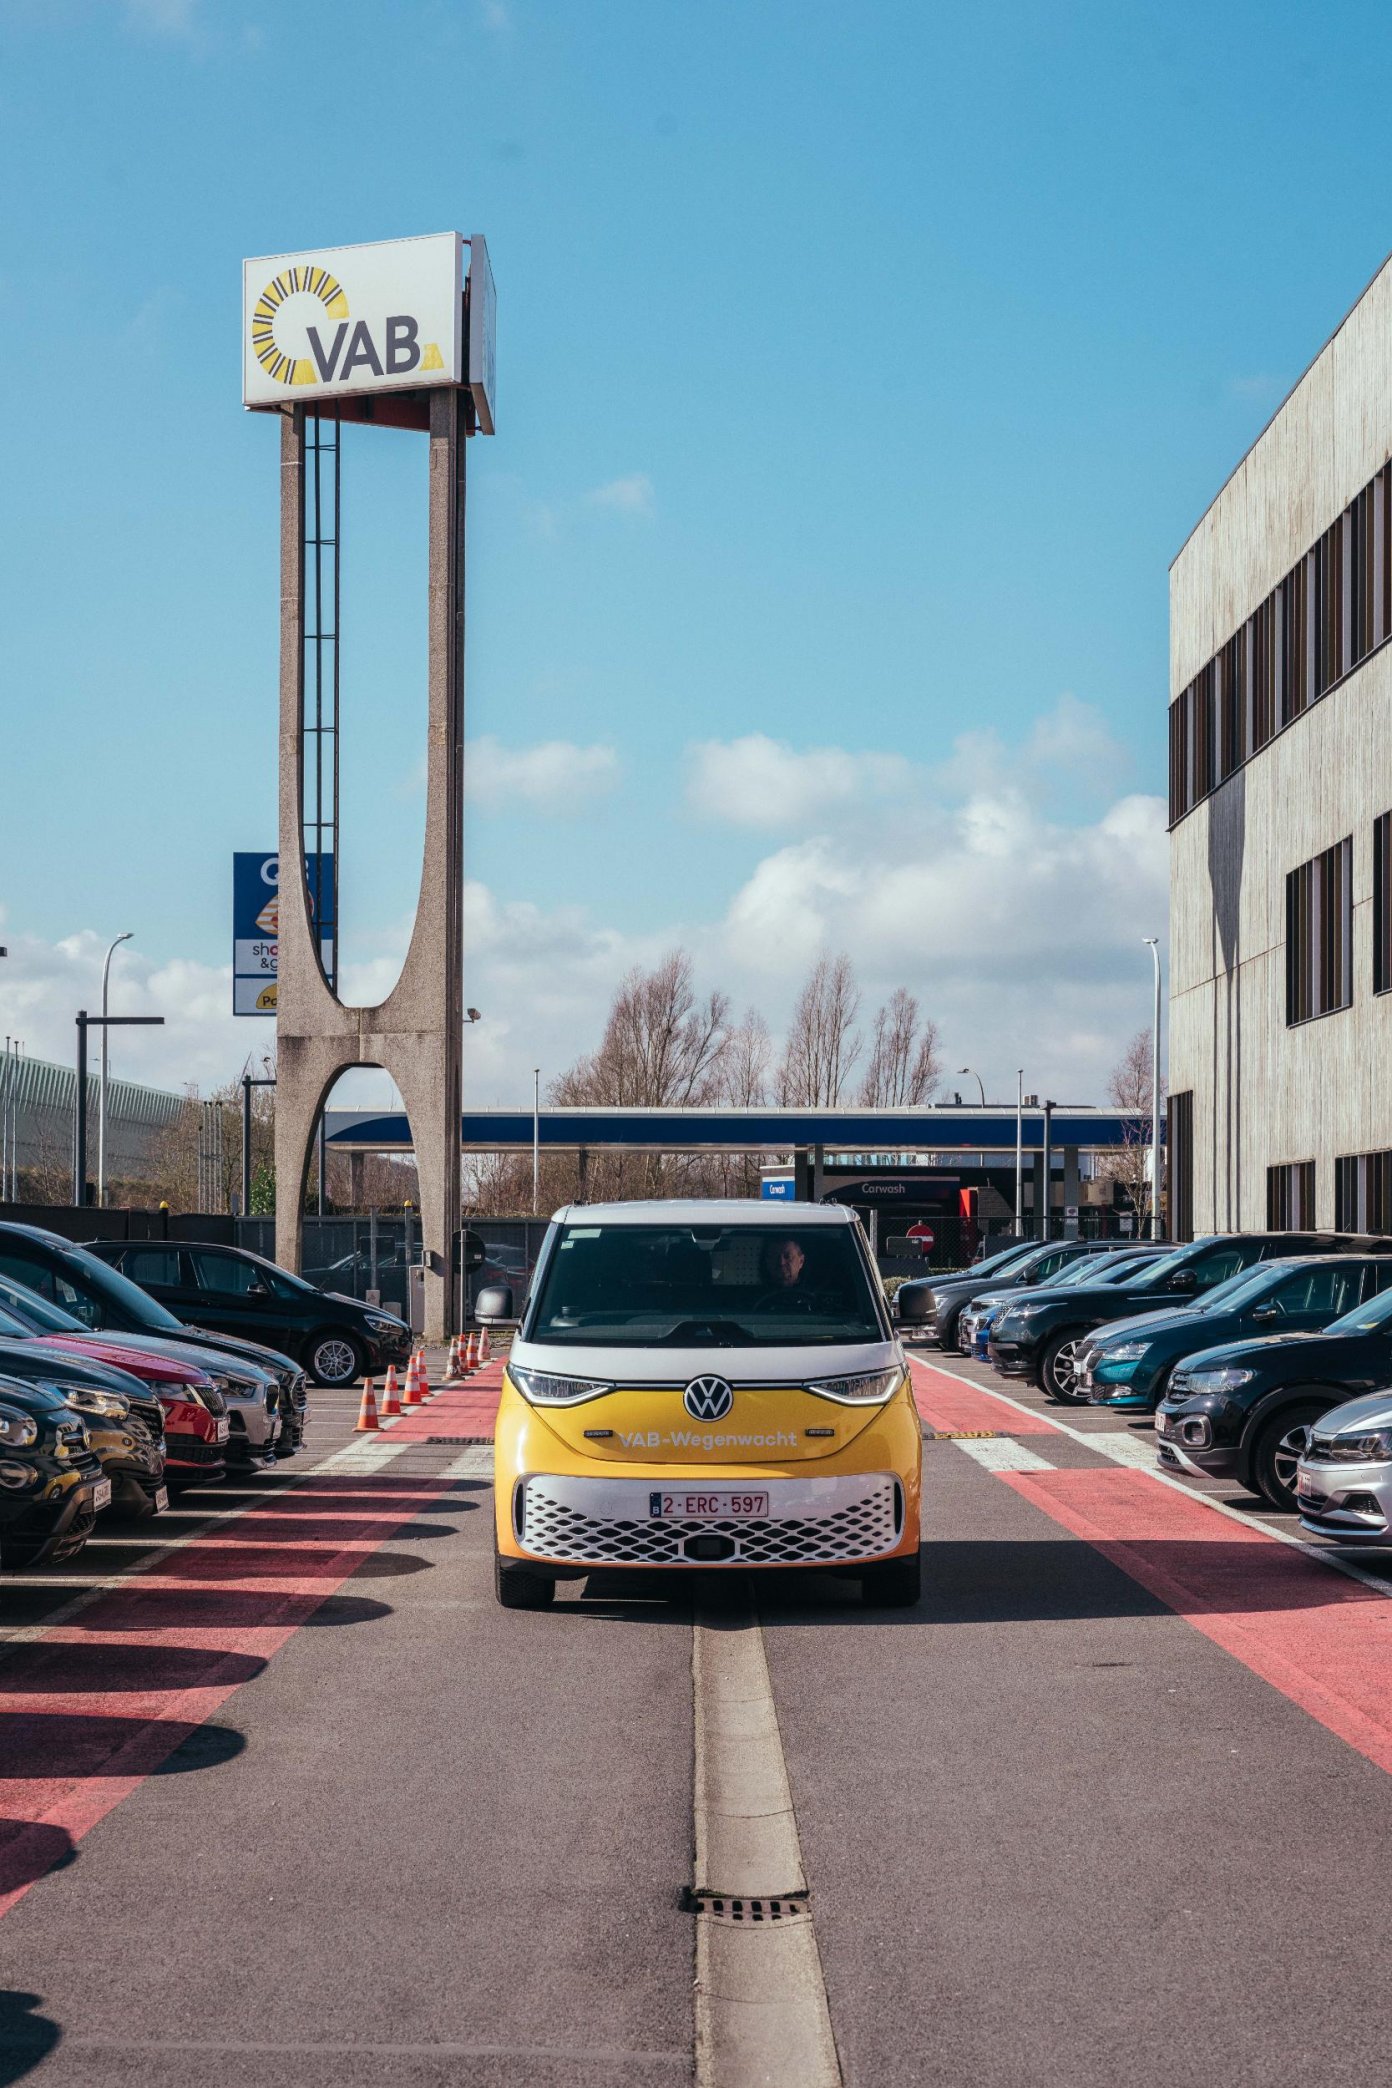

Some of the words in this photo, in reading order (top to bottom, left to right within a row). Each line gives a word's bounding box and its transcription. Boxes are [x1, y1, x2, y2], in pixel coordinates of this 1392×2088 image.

[306, 315, 421, 384] VAB
[252, 942, 278, 956] sho
[861, 1183, 906, 1194] Carwash
[619, 1430, 798, 1451] VAB-Wegenwacht
[652, 1506, 660, 1515] B
